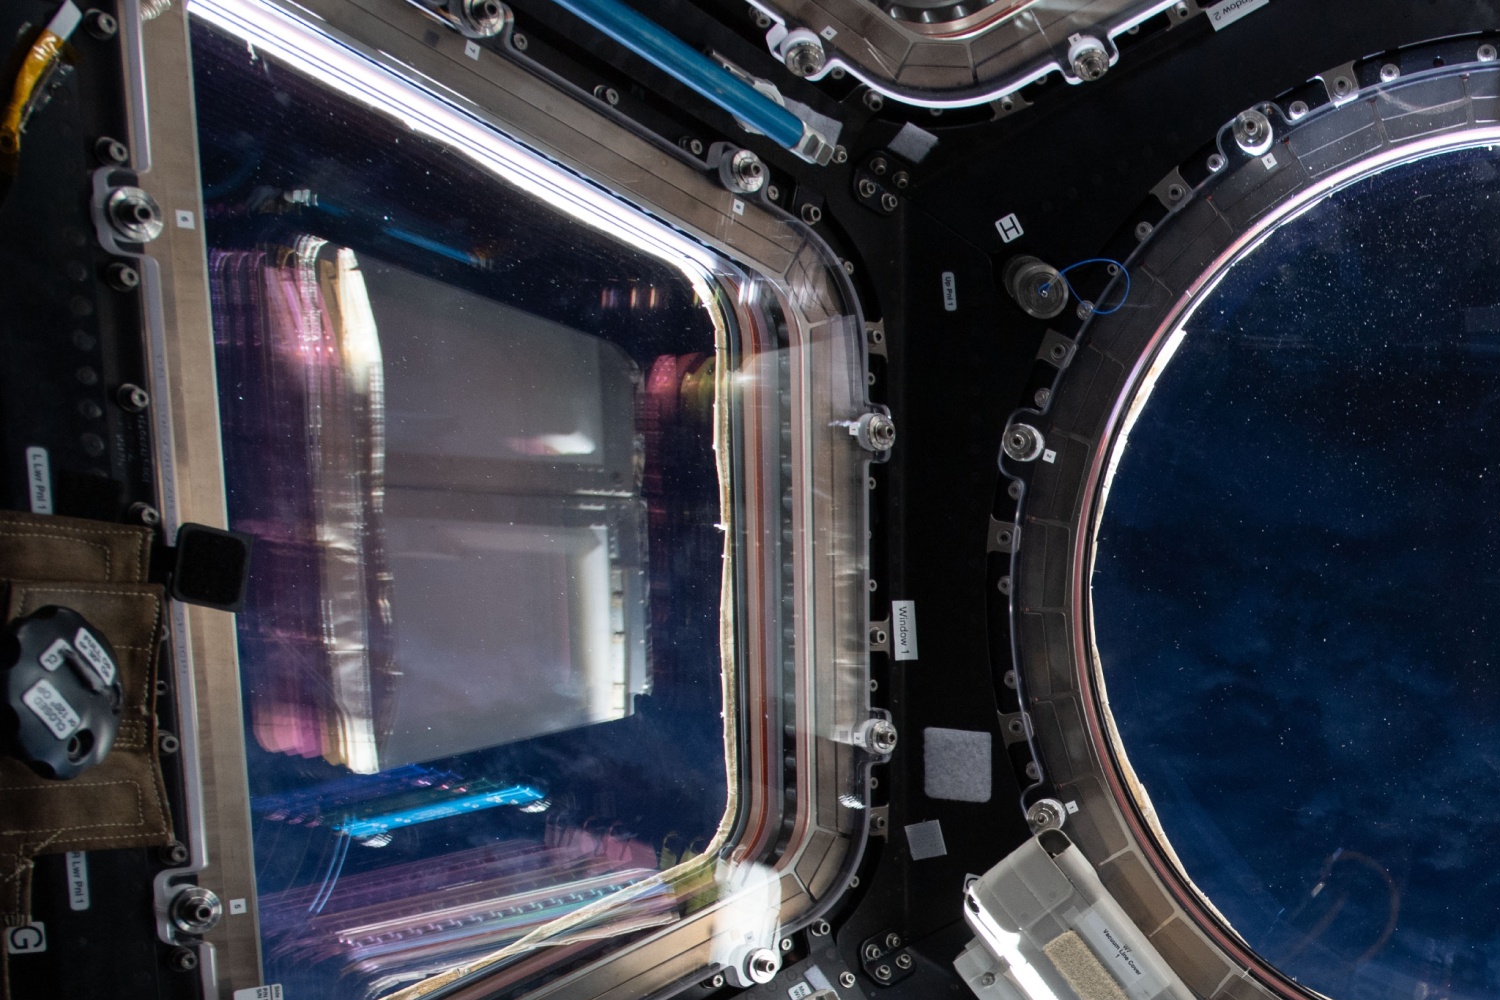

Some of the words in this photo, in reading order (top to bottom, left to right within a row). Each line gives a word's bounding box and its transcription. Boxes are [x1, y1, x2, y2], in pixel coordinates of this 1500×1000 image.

[1212, 10, 1222, 21] 2
[998, 215, 1020, 240] H
[944, 276, 951, 286] Up
[945, 288, 953, 300] Pnl
[32, 462, 44, 482] Lwr
[34, 483, 46, 502] Pnl
[898, 606, 909, 645] Window
[36, 682, 53, 700] OP
[31, 692, 66, 734] CLOSED
[71, 860, 81, 878] Lwr
[73, 880, 84, 896] Pnl
[10, 925, 43, 949] G
[1101, 928, 1121, 950] Vacuum
[1118, 948, 1130, 961] Line
[1127, 959, 1142, 976] Cover
[1122, 943, 1132, 953] W7
